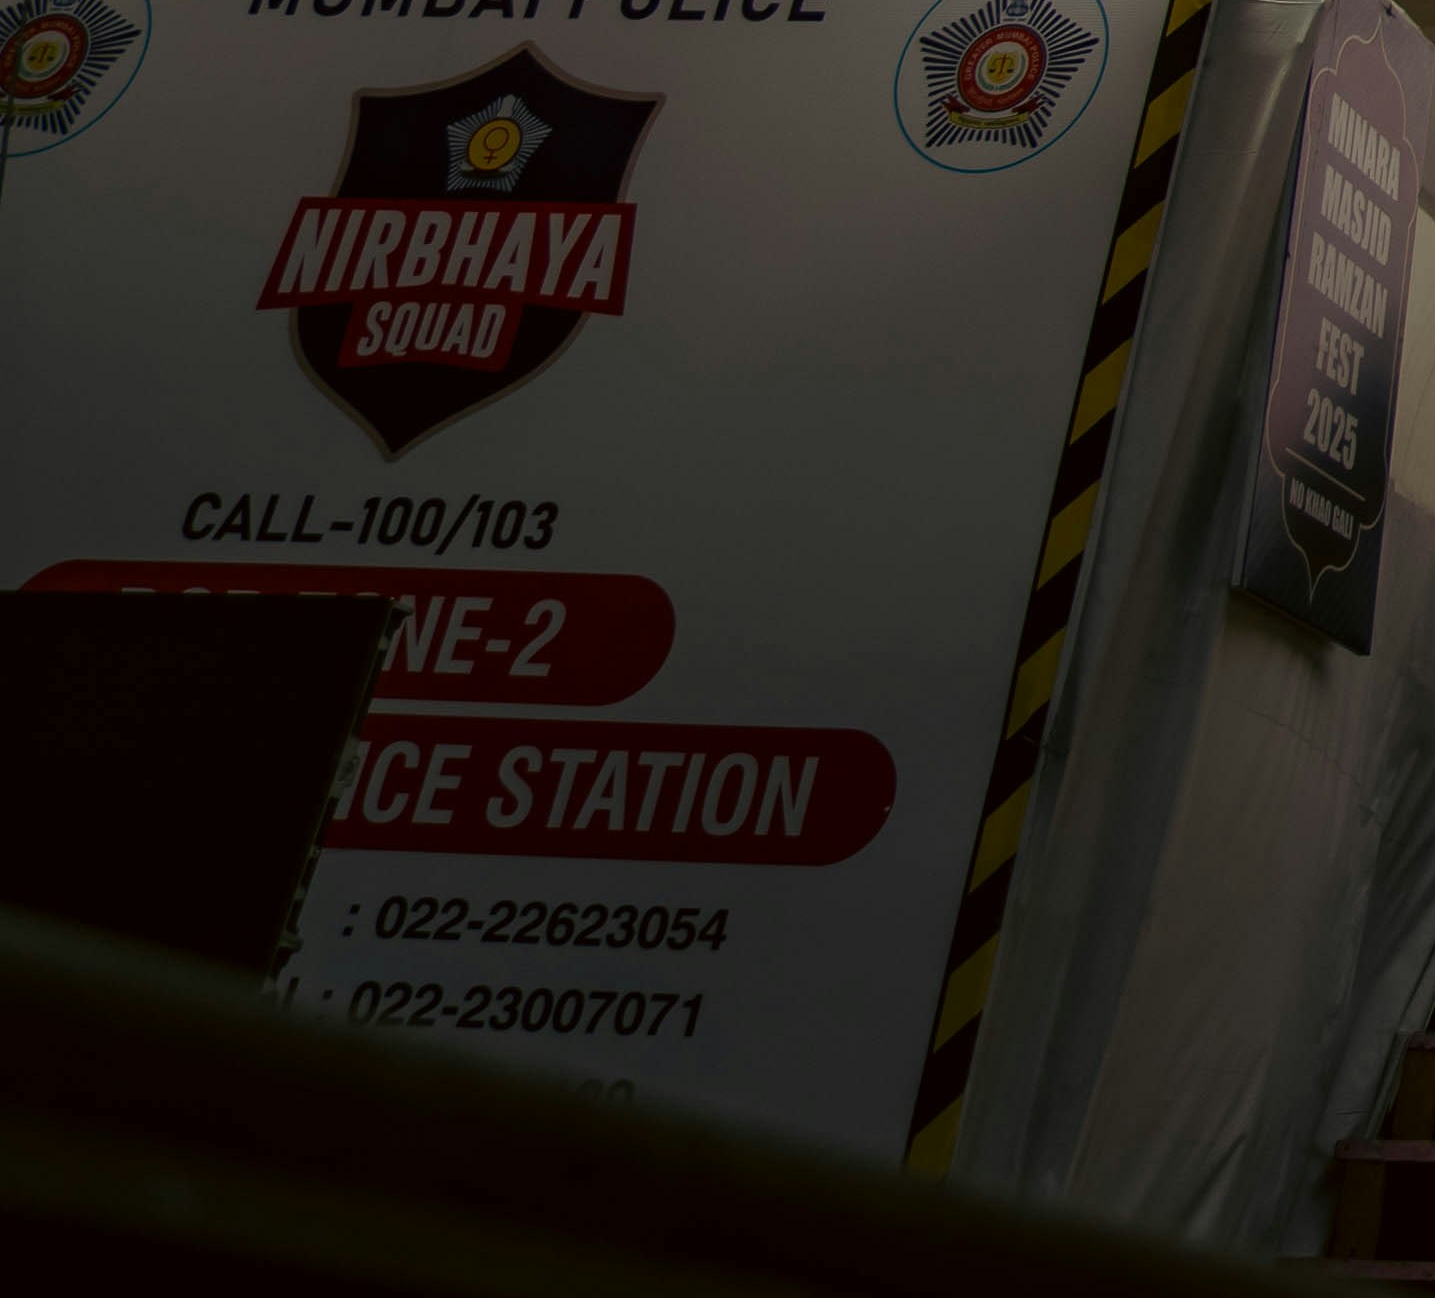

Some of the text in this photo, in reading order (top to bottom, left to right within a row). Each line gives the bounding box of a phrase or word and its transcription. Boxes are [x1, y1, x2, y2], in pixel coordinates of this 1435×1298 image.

[1327, 91, 1401, 202] MINARA
[277, 207, 622, 301] NIRBHAYA
[1320, 163, 1392, 266] MASJID
[1307, 231, 1389, 339] RAMZAN
[356, 300, 507, 360] SQUAD
[1315, 316, 1365, 396] FEST
[1303, 388, 1359, 471] 2025
[181, 491, 559, 556] CALL-100/103
[330, 740, 820, 837] ICE STATION
[375, 895, 729, 951] 022-22623054
[348, 980, 704, 1038] 022-23007071
